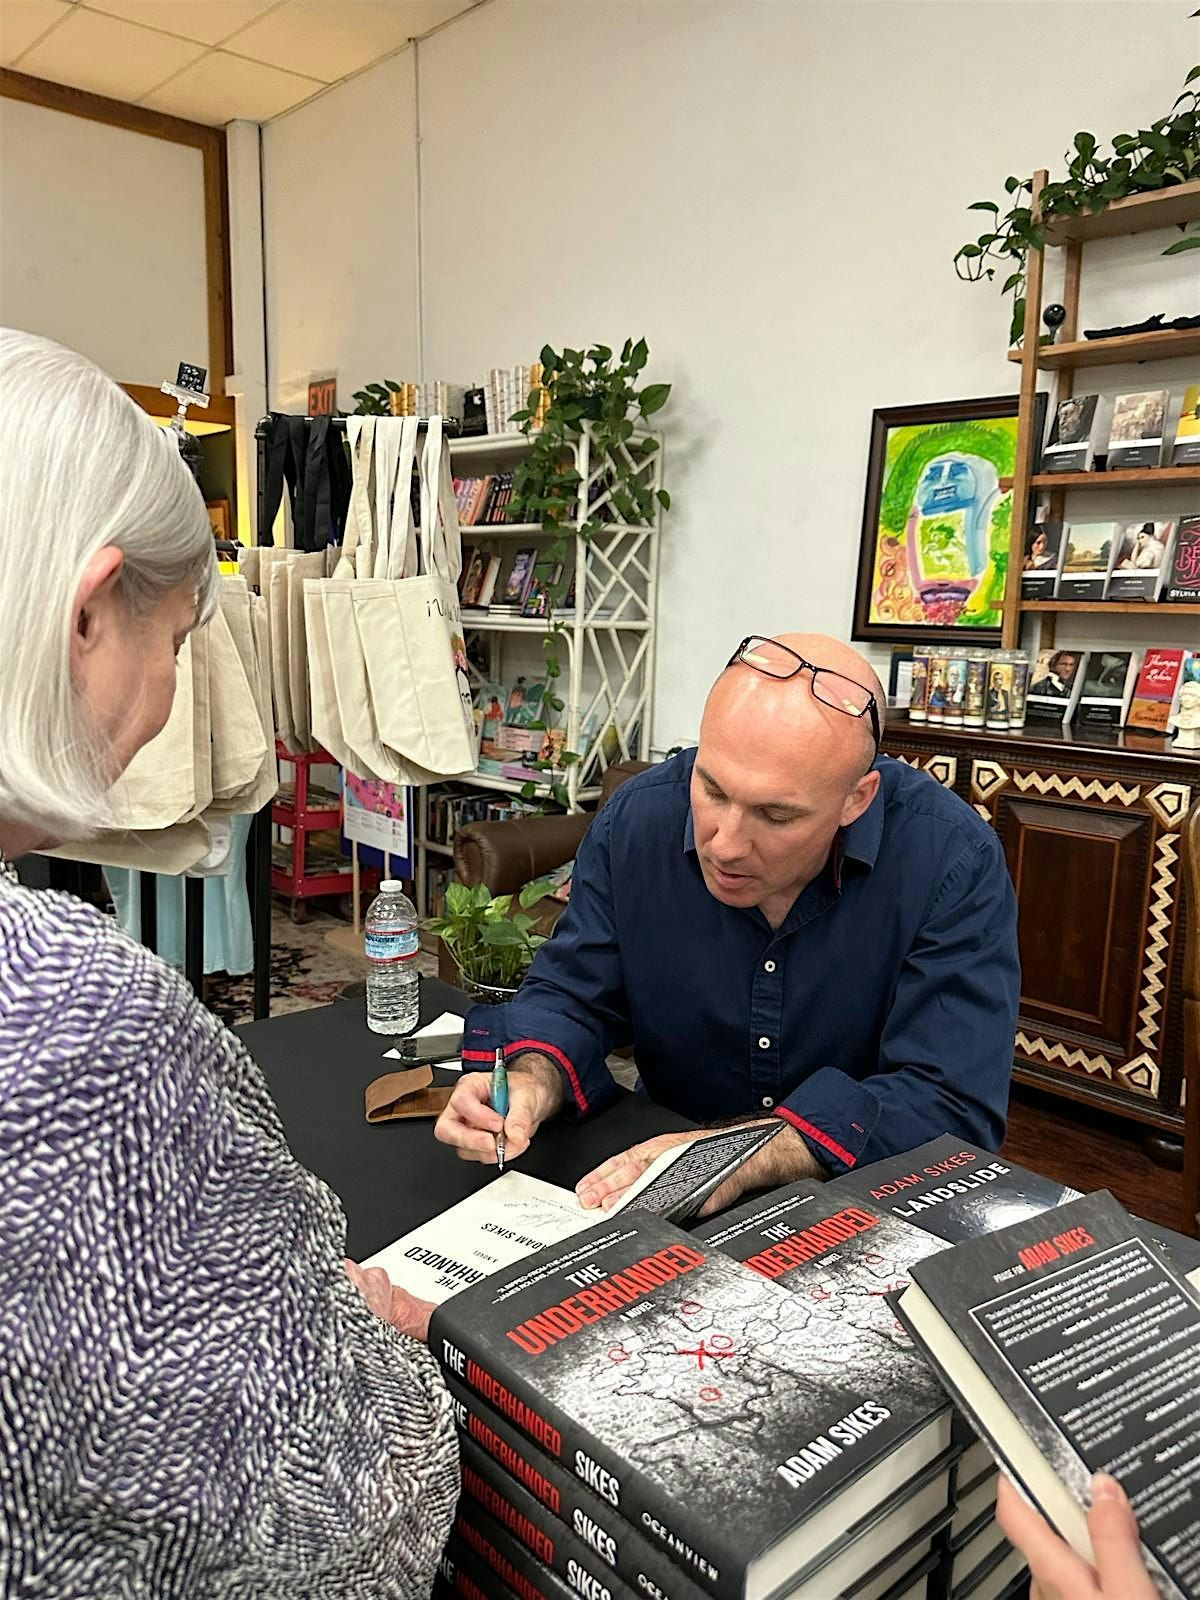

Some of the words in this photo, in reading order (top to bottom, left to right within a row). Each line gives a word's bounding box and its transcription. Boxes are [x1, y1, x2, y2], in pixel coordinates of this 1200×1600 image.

[309, 382, 336, 416] EXIT
[1170, 588, 1196, 597] SYLVIA
[869, 1173, 925, 1200] ADAM
[923, 1151, 976, 1177] SIKES
[891, 1162, 1011, 1217] LANDSLIDE
[481, 1222, 516, 1239] SIKES
[741, 1206, 881, 1279] DERHANDED
[760, 1222, 798, 1242] THE
[1017, 1240, 1060, 1271] ADAM
[1052, 1226, 1095, 1255] SIKES
[404, 1246, 486, 1284] RHANDED
[435, 1275, 459, 1290] THE
[565, 1263, 608, 1288] THE
[506, 1244, 706, 1355] UNDERHANDED
[626, 1301, 656, 1319] NOVEL
[443, 1339, 465, 1377] THE
[467, 1360, 561, 1456] UNDERHANDED
[575, 1450, 619, 1506] SIKES
[641, 1512, 719, 1581] OCEANVIEW
[777, 1435, 843, 1488] ADAM
[828, 1400, 891, 1445] SIKES
[452, 1397, 467, 1430] HE
[469, 1412, 560, 1513] UNDERHANDED
[573, 1508, 616, 1566] SIKES
[441, 1555, 455, 1585] HE
